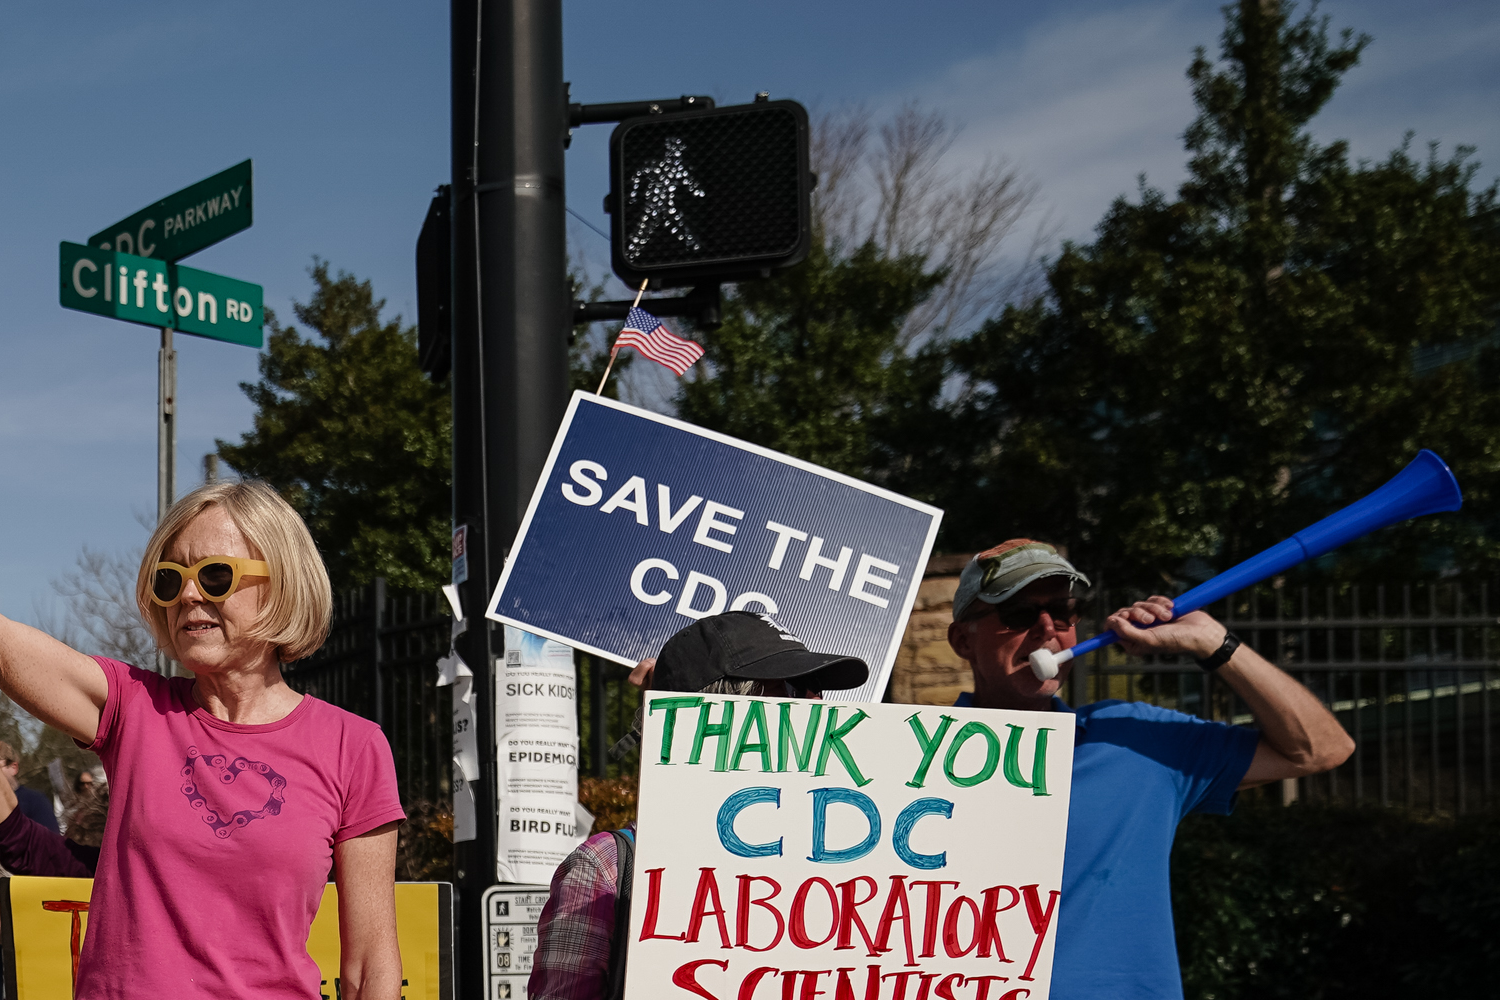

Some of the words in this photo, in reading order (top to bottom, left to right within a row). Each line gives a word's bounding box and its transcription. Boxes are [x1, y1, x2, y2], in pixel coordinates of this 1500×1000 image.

[100, 219, 156, 258] DC
[163, 185, 243, 239] PARKWAY
[72, 258, 217, 324] Clifton
[226, 298, 253, 323] RD
[561, 459, 745, 554] SAVE
[766, 520, 901, 608] THE
[506, 683, 544, 697] SICK
[649, 696, 873, 787] THANK
[904, 711, 1057, 796] YOU
[510, 820, 551, 833] BIRD
[716, 786, 955, 869] CDC
[638, 866, 1061, 981] LABORATORY
